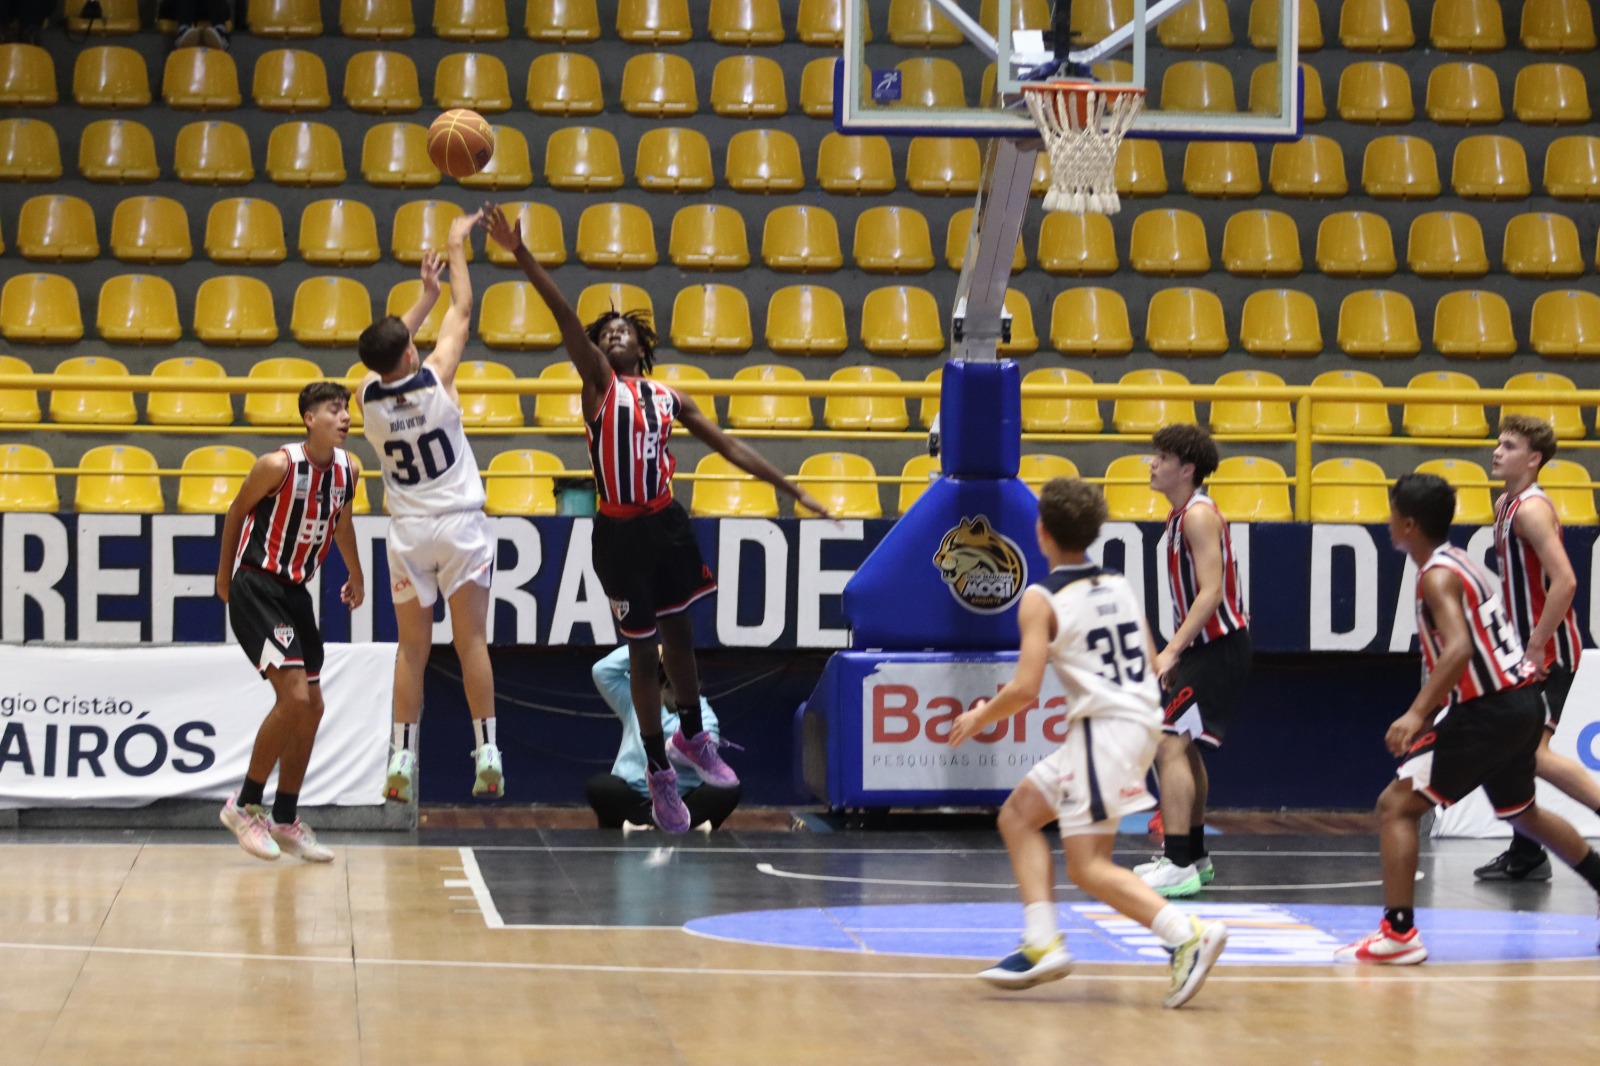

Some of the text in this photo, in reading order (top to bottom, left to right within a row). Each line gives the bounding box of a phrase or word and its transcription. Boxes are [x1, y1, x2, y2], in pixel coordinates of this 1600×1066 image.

[384, 428, 455, 485] 30
[635, 431, 659, 460] 18
[298, 519, 330, 544] 99
[3, 513, 864, 648] REFTRA DE
[962, 581, 1012, 597] MOGI
[1086, 621, 1146, 687] 35
[43, 695, 134, 716] Cristão
[0, 710, 217, 778] AIRÓS
[872, 753, 970, 768] PESQUISAS
[978, 752, 999, 767] DE
